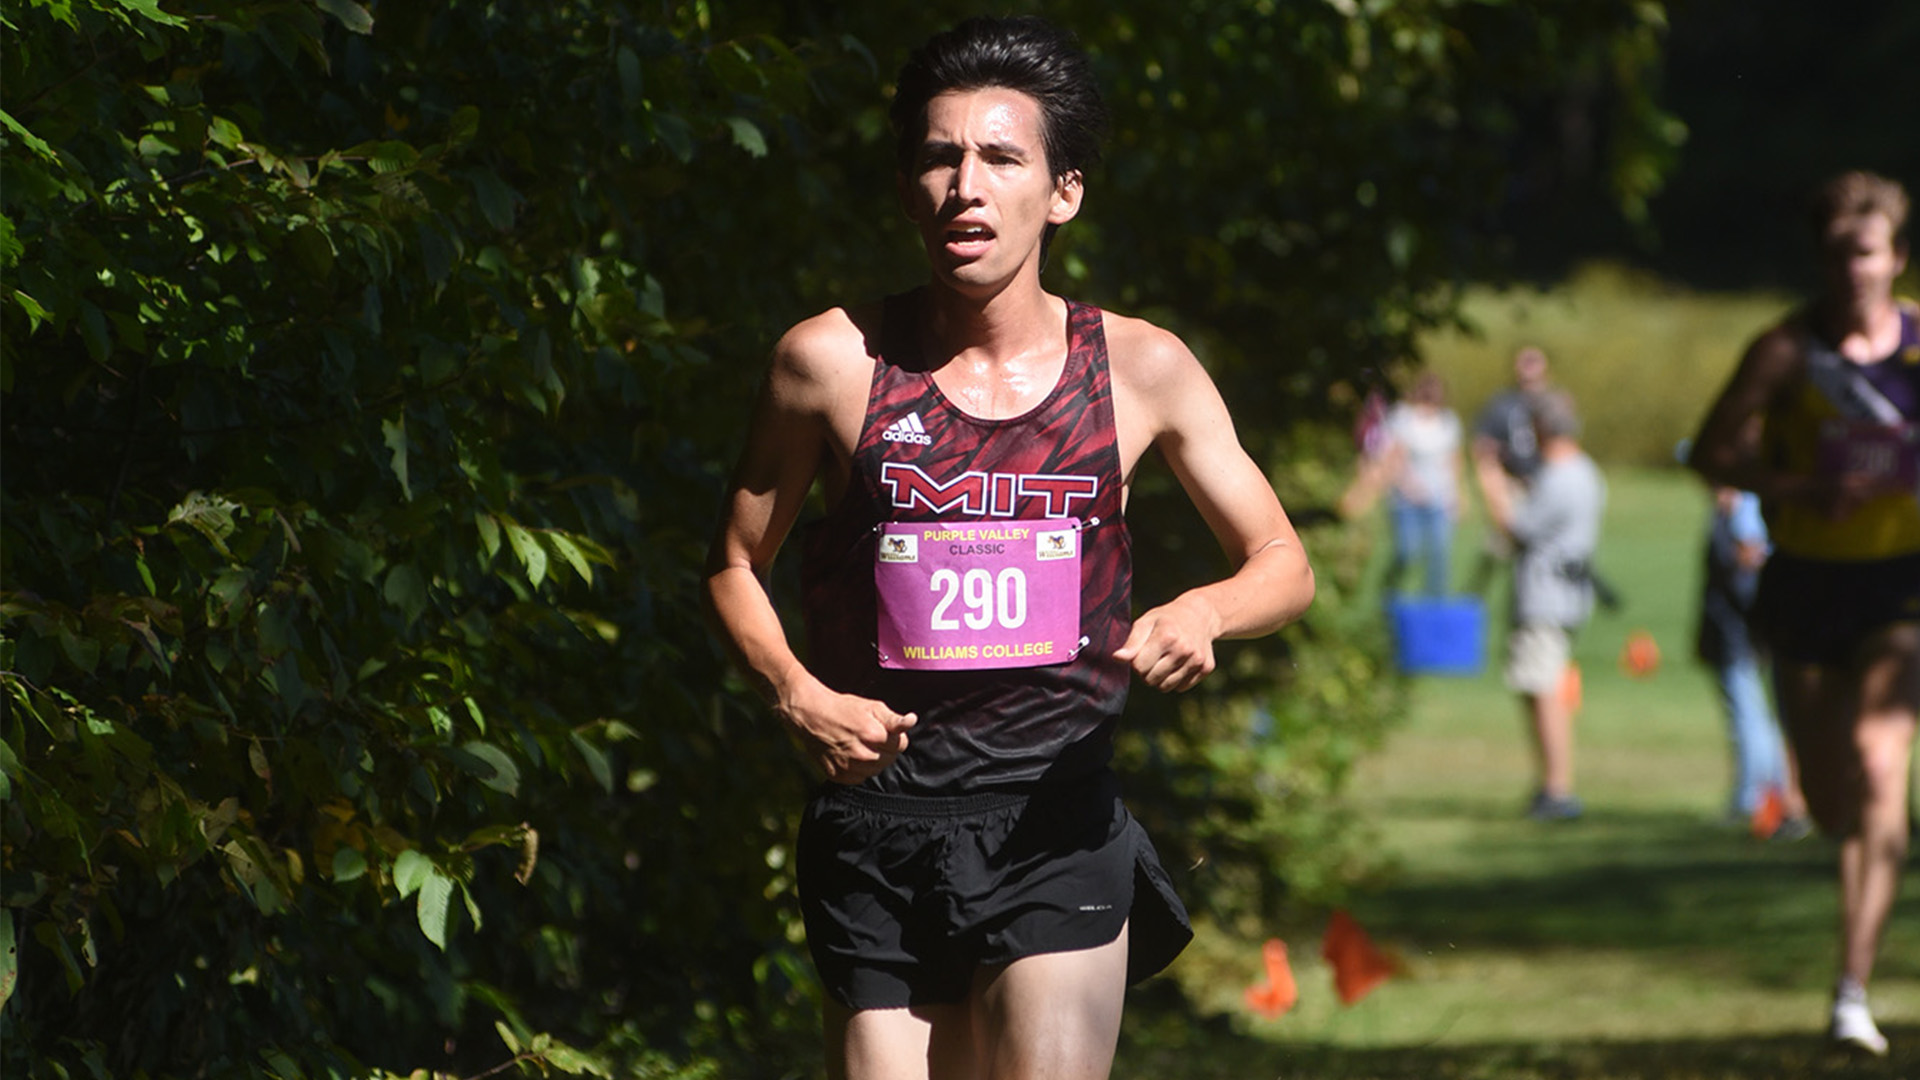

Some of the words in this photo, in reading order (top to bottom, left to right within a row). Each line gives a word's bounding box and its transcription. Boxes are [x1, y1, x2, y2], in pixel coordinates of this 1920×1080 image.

[882, 429, 932, 446] adidas
[881, 462, 1099, 519] MIT
[923, 530, 976, 542] PURPLE
[978, 528, 1030, 541] VALLEY
[949, 543, 1006, 556] CLASSIC
[929, 567, 1027, 631] 290
[903, 645, 979, 660] WILLIAMS
[982, 641, 1054, 659] COLLEGE
